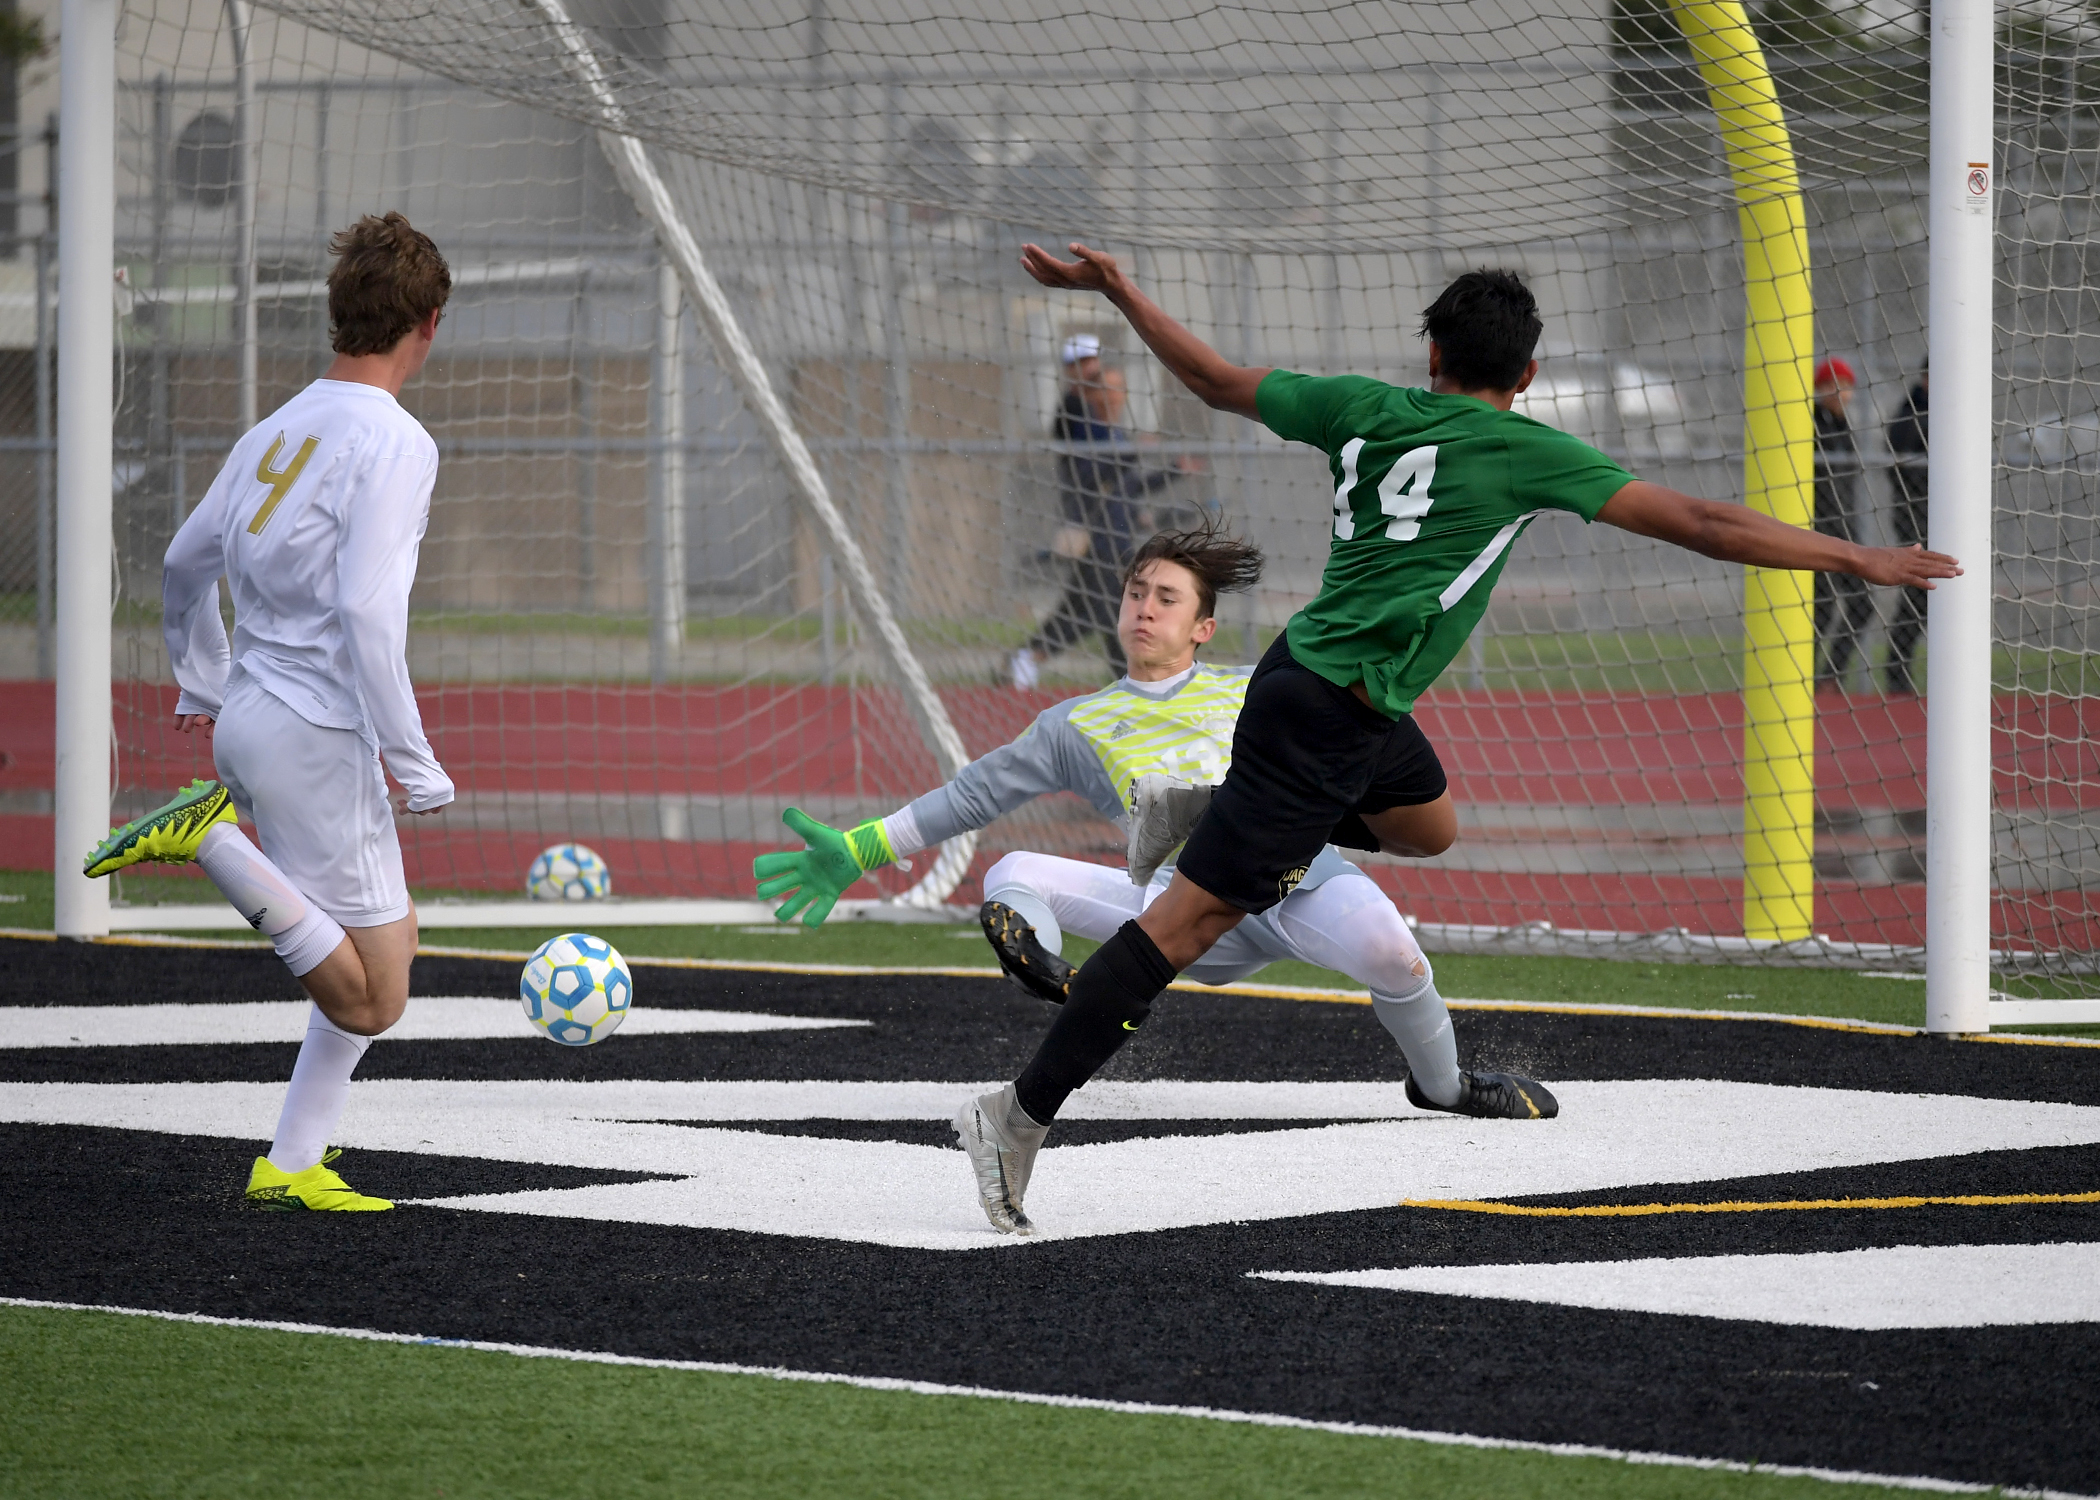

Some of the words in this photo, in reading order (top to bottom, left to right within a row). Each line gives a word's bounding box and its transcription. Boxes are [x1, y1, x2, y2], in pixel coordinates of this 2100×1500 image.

[247, 430, 321, 536] 4
[1334, 438, 1438, 540] 14
[1161, 740, 1227, 786] 13
